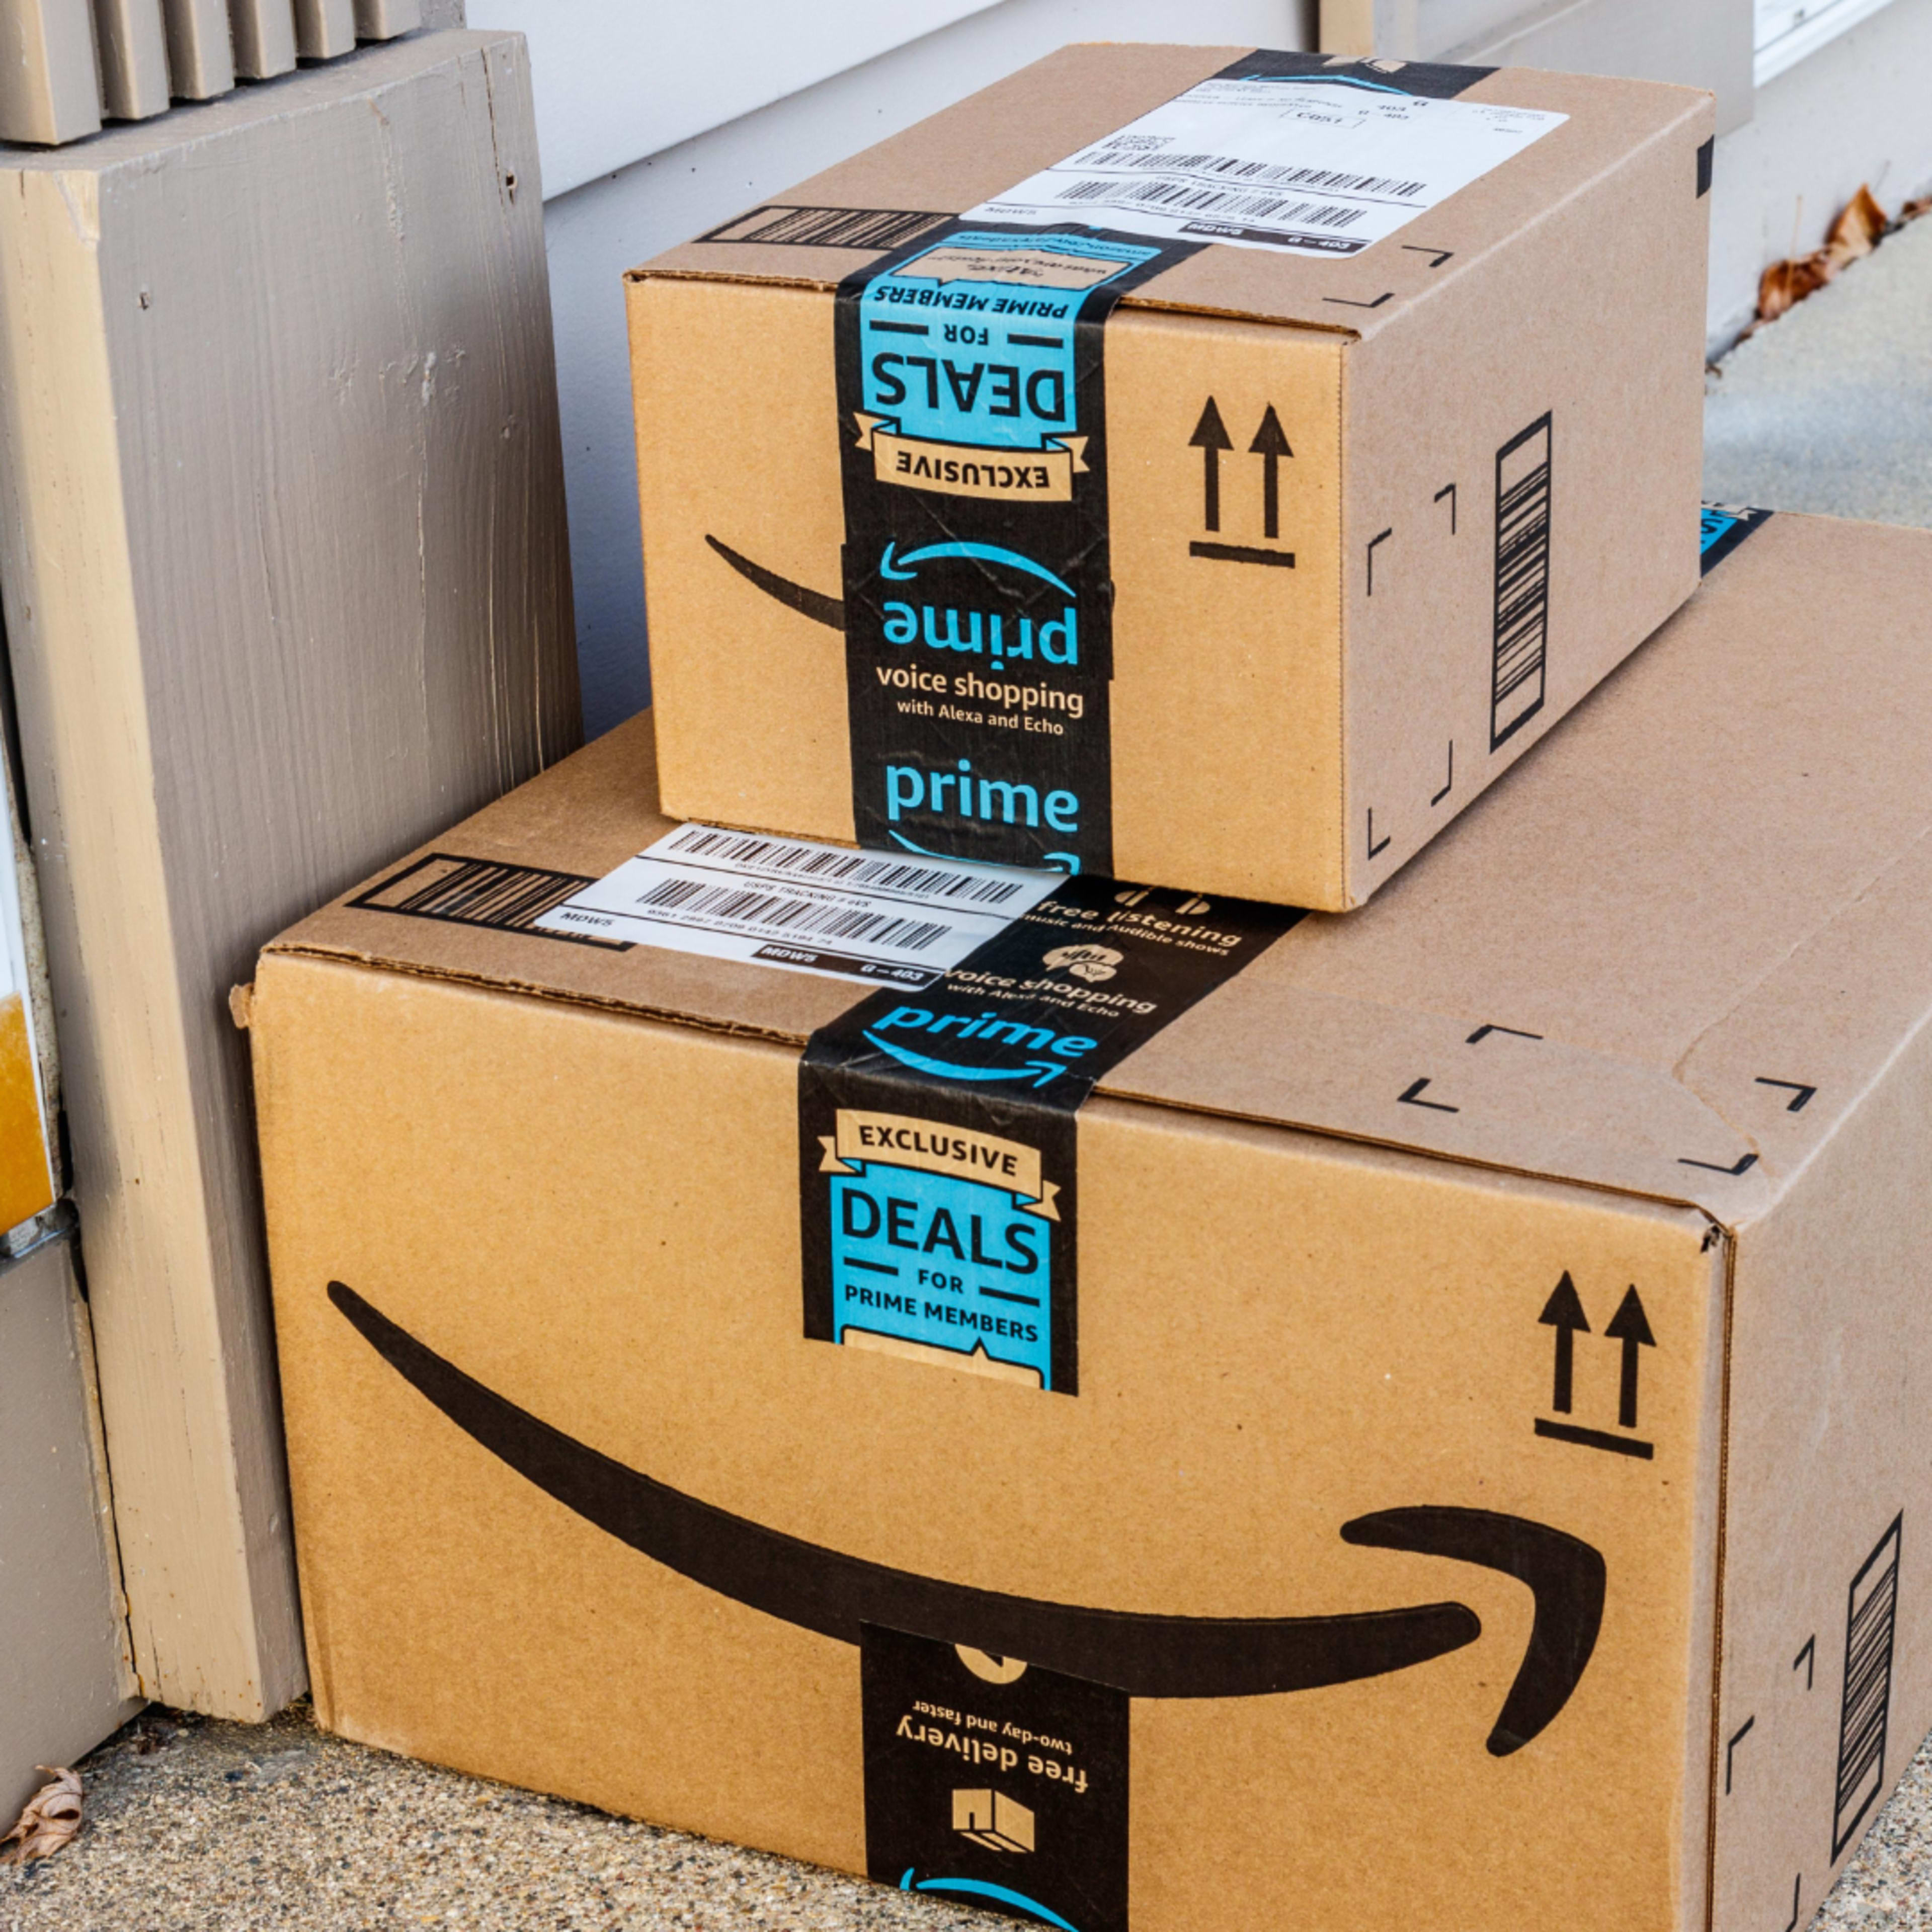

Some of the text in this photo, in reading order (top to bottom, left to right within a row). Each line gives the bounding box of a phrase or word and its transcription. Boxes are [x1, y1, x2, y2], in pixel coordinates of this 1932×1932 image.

[874, 286, 1069, 318] PRIME MEMBERS
[944, 324, 990, 346] FOR
[871, 352, 1066, 423] DEALS
[897, 450, 1050, 488] EXCLUSIVE
[882, 601, 1079, 670] prime
[876, 664, 1083, 718] voice shopping
[897, 700, 1064, 736] with Alexa and Echo
[886, 759, 1079, 833] prime
[1036, 901, 1242, 947] free listening
[1071, 922, 1105, 932] and
[1106, 923, 1173, 944] Audible
[1175, 939, 1230, 956] shows
[760, 946, 819, 963] MDW5
[944, 969, 1157, 1015] voice shopping
[946, 983, 1120, 1017] with Alexa and Echo
[871, 1006, 1098, 1057] prime
[858, 1125, 1018, 1177] EXCLUSIVE
[842, 1187, 1038, 1274] DEALS
[918, 1269, 964, 1294] FOR
[845, 1284, 1038, 1342] PRIME MEMBERS
[912, 1700, 1074, 1756] two-day and faster
[896, 1715, 1089, 1794] free delivery
